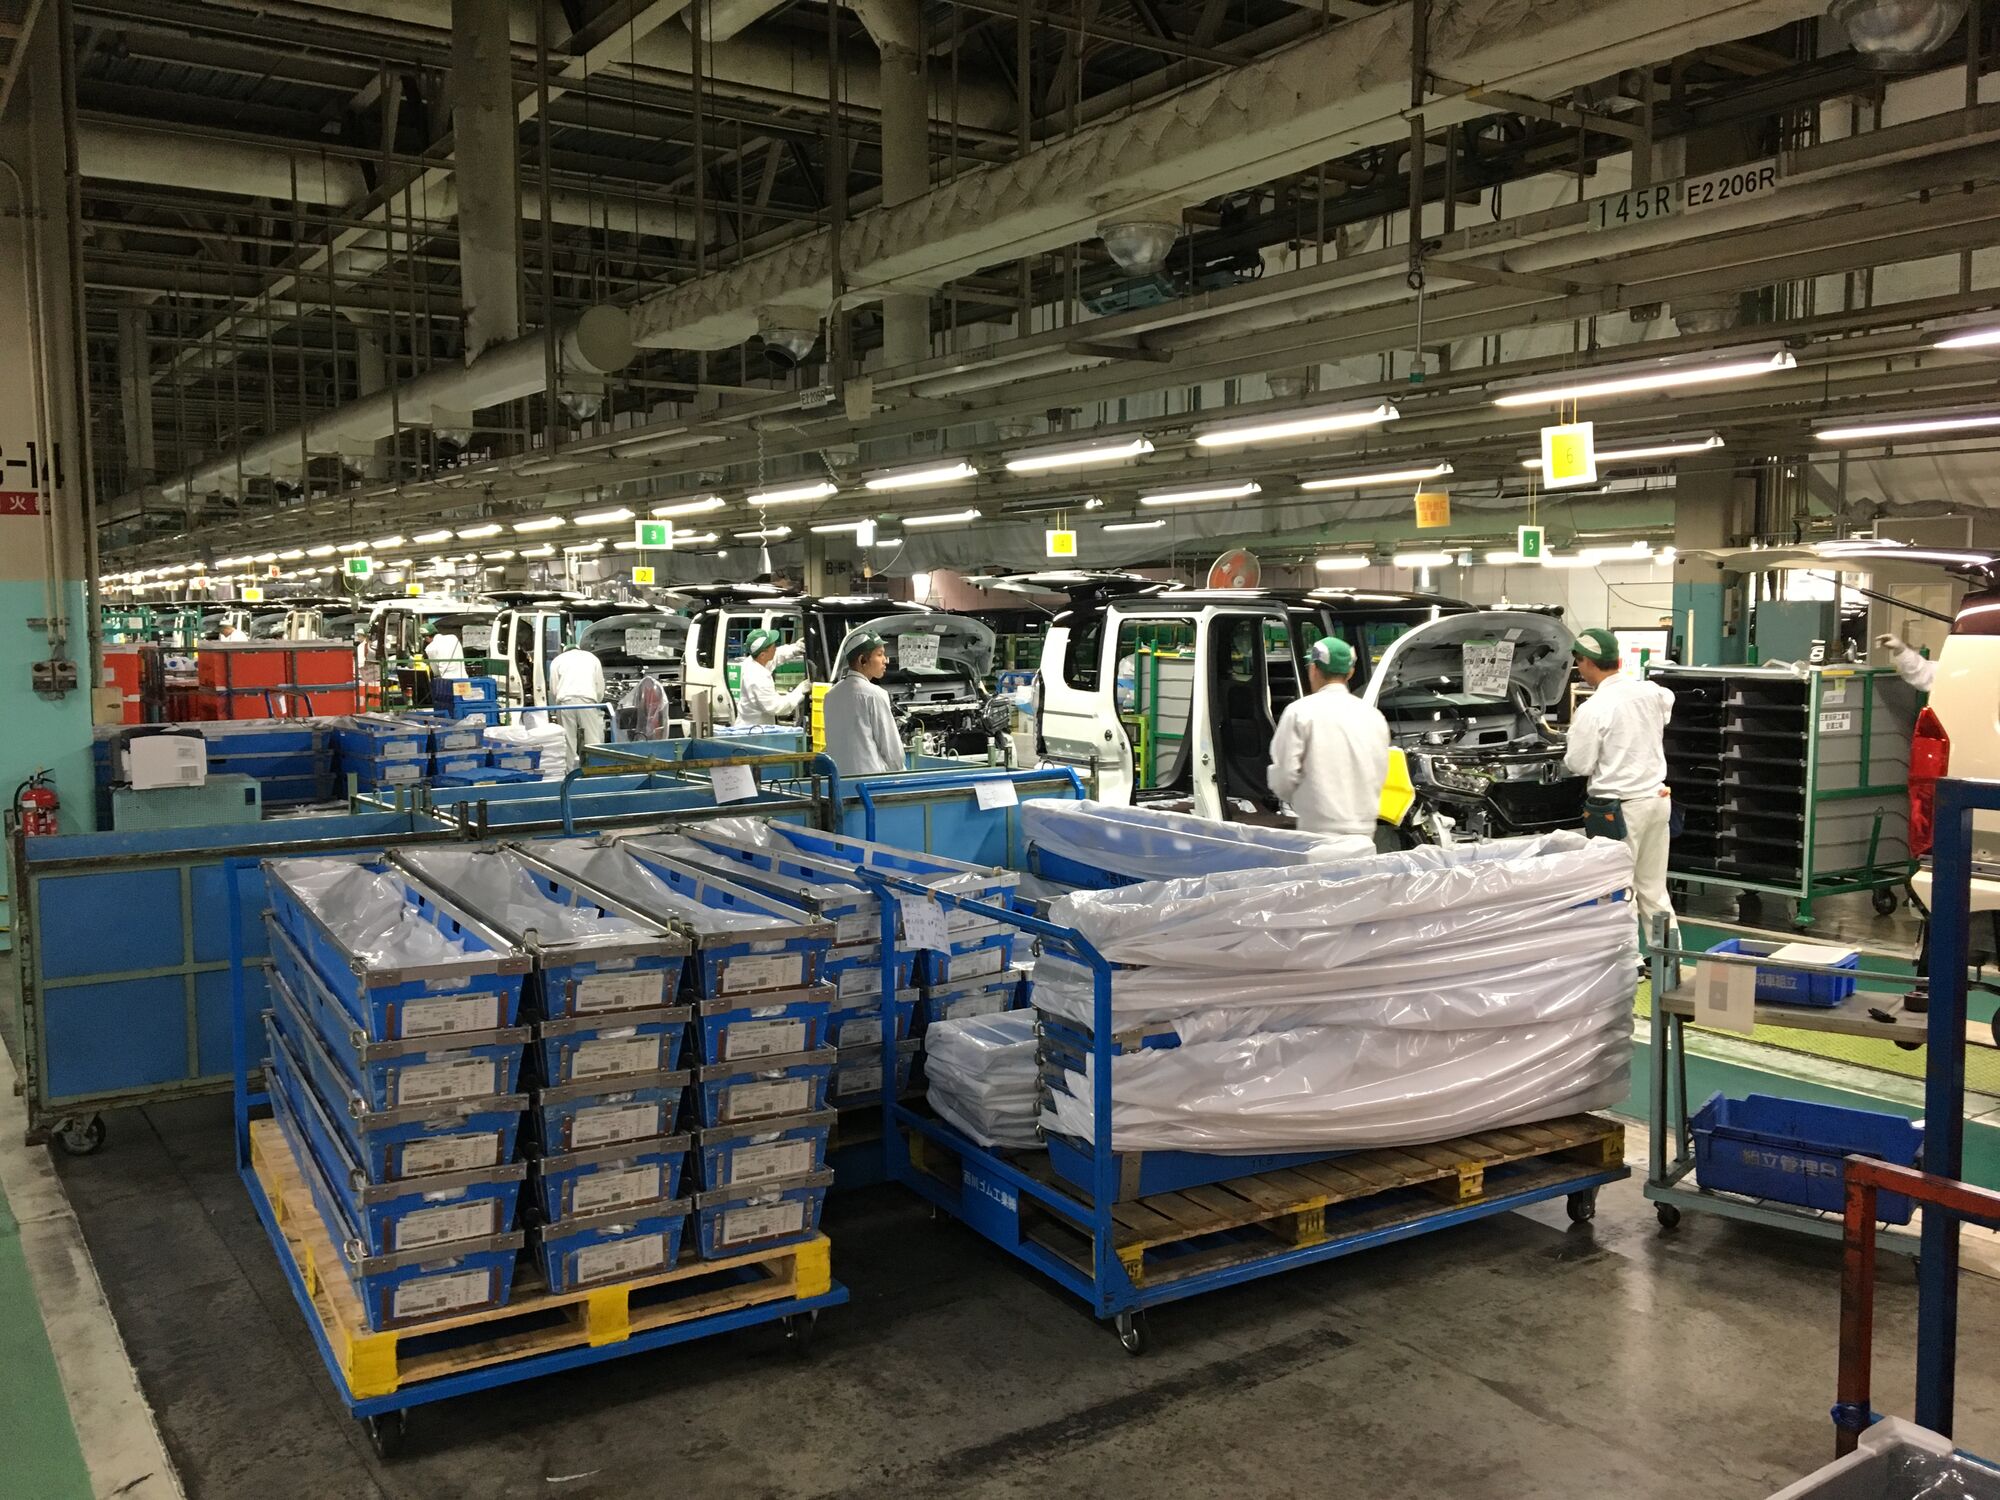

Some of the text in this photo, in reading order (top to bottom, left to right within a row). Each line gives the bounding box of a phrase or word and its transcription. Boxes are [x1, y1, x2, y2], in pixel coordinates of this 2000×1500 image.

[1598, 185, 1671, 228] 145R
[1566, 447, 1574, 465] 6
[650, 530, 658, 540] 3
[1528, 538, 1535, 551] 5
[640, 570, 647, 582] 2
